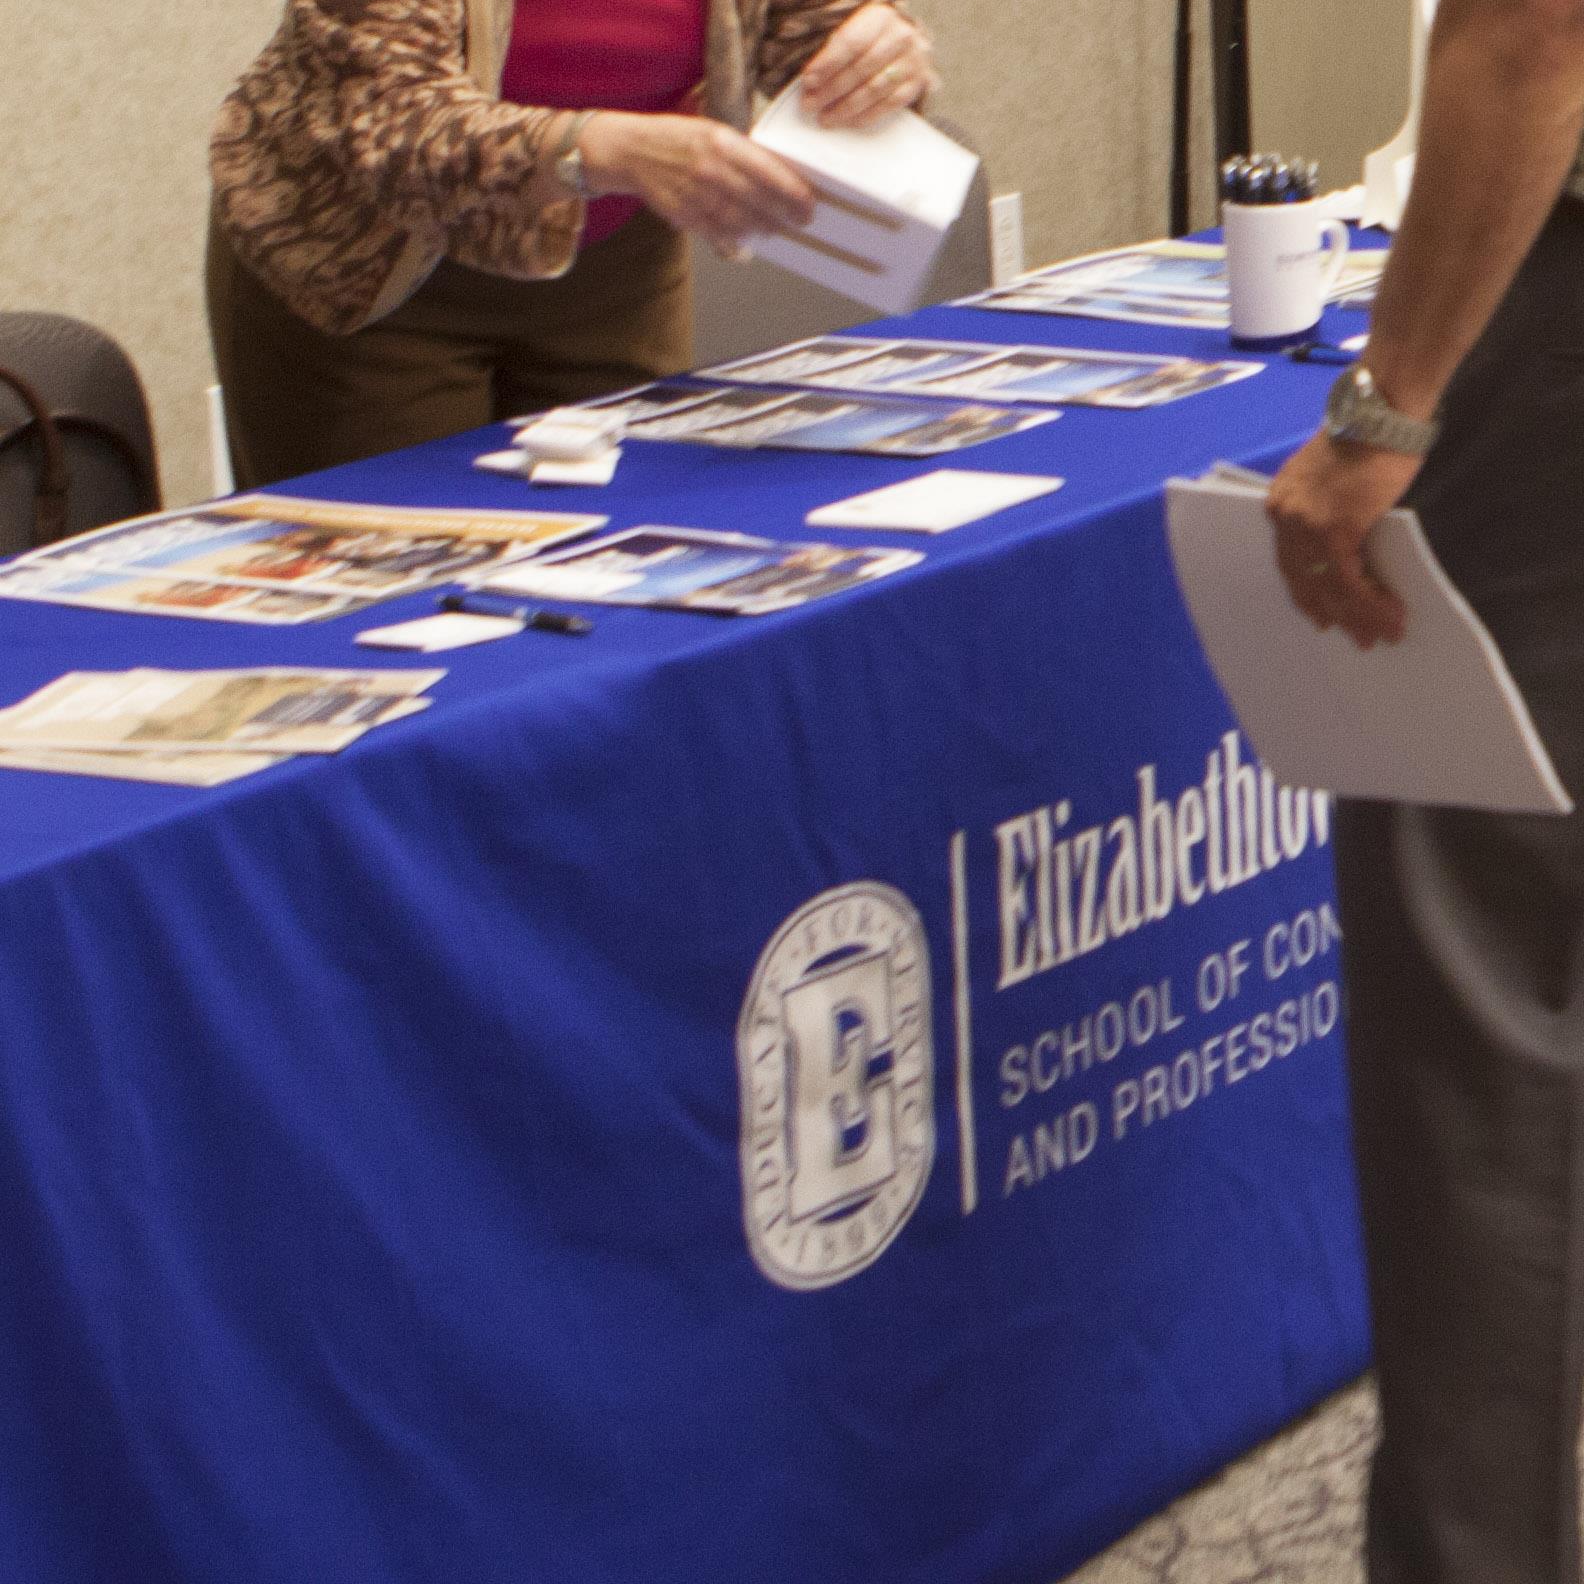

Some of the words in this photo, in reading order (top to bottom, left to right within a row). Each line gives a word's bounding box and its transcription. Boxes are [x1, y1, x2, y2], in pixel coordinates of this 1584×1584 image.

[1000, 975, 1186, 1109] SCHOOL
[1195, 937, 1253, 1015] OF
[1002, 1100, 1099, 1199] AND
[1111, 979, 1340, 1142] PROFESSIO
